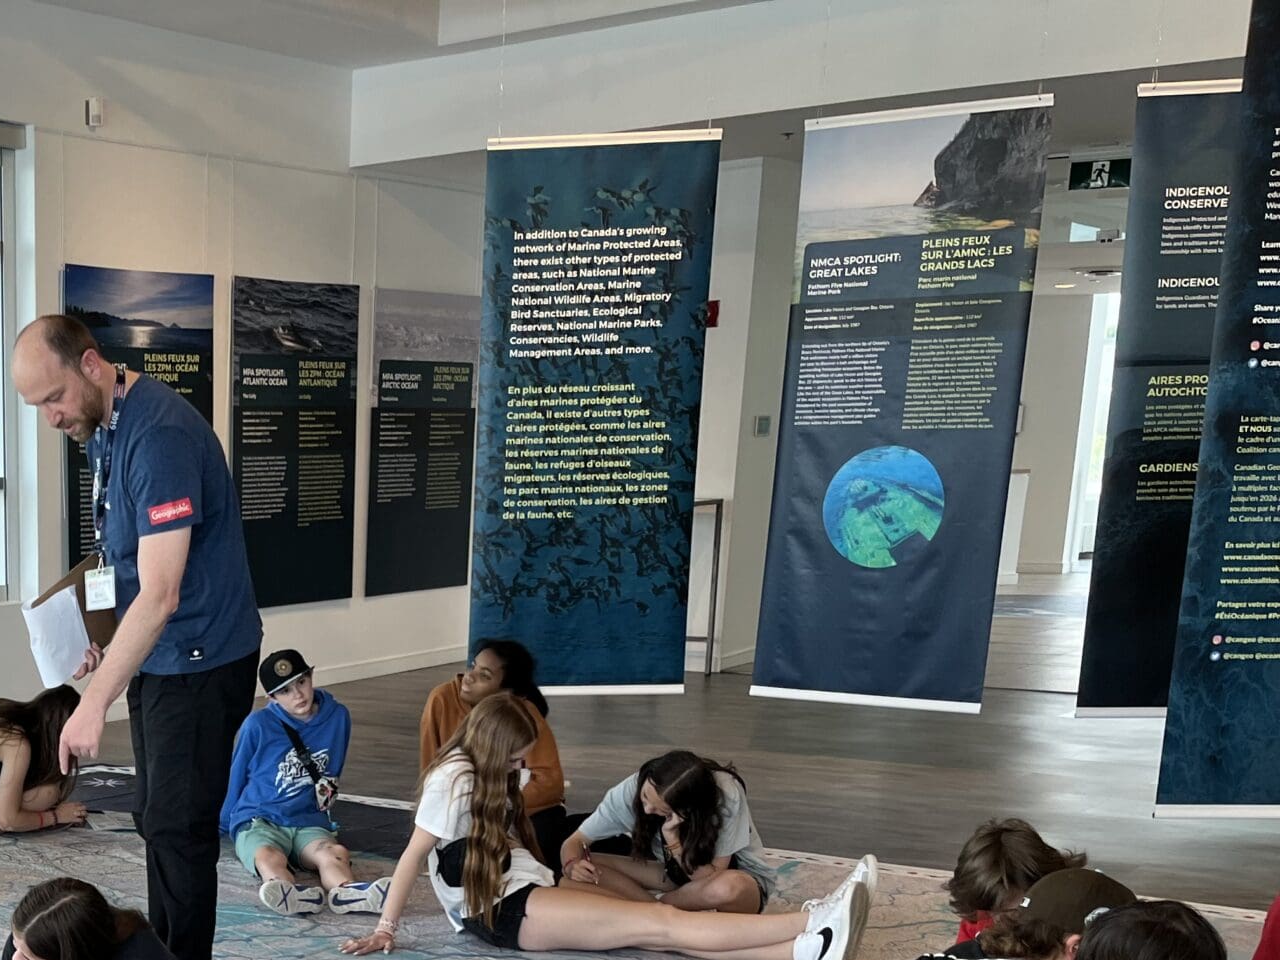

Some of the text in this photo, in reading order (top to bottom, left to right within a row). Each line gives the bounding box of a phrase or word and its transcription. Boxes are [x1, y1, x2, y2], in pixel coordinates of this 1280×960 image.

[514, 225, 667, 240] In addition to Canada's growing
[513, 243, 554, 254] network
[555, 242, 567, 252] of
[567, 241, 601, 252] Marine
[602, 238, 651, 250] Protected
[922, 235, 991, 249] PLEINS FEUX
[513, 250, 682, 267] there exist other types of protected
[921, 245, 1013, 260] SUR L'AMNC LES
[810, 252, 902, 268] NMCA SPOTLIGHT:
[920, 258, 995, 272] GRANDS LACS
[542, 269, 565, 279] such
[566, 270, 578, 278] as
[579, 266, 620, 278] National
[622, 265, 656, 276] Marine
[809, 265, 878, 279] GREAT LAKES
[511, 282, 575, 293] Conservation
[608, 279, 642, 289] Marine
[511, 296, 552, 306] National
[553, 294, 591, 305] Wildlife
[624, 292, 672, 303] Migratory
[510, 309, 531, 319] Bird
[592, 305, 642, 317] Ecological
[556, 320, 597, 330] National
[598, 319, 632, 329] Marine
[581, 332, 619, 343] Wildlife
[144, 353, 200, 363] PLEINS FEUX SUR
[509, 348, 572, 359] Management
[604, 345, 624, 355] and
[625, 346, 654, 354] more.
[144, 362, 199, 372] LES ZPM OCÉAN
[1148, 375, 1182, 385] AIRES
[508, 382, 635, 396] En plus du réseau croissant
[507, 394, 642, 407] d'aires marines protégées du
[546, 410, 552, 419] il
[554, 410, 582, 419] existe
[583, 409, 622, 418] d'autres
[623, 408, 650, 418] types
[506, 423, 537, 433] d'aires
[589, 422, 626, 430] comme
[627, 420, 641, 429] les
[642, 420, 666, 429] aires
[1250, 425, 1272, 433] NOUS
[505, 436, 544, 445] marines
[545, 434, 594, 444] nationales
[595, 434, 608, 443] de
[505, 445, 664, 458] les réserves marines nationales de
[535, 461, 548, 470] les
[550, 460, 585, 470] refuges
[586, 458, 631, 468] d'oiseaux
[1139, 461, 1199, 473] GARDIENS
[558, 472, 571, 481] les
[572, 472, 611, 481] réserves
[503, 486, 517, 495] les
[518, 487, 539, 496] parc
[541, 485, 573, 494] marins
[625, 483, 639, 492] les
[640, 484, 668, 492] zones
[502, 498, 516, 508] de
[579, 496, 593, 506] les
[594, 496, 617, 505] aires
[618, 495, 631, 505] de
[632, 494, 668, 506] gestion
[151, 502, 190, 520] Geographic
[502, 511, 515, 520] de
[516, 511, 525, 520] la
[556, 510, 574, 519] etc.
